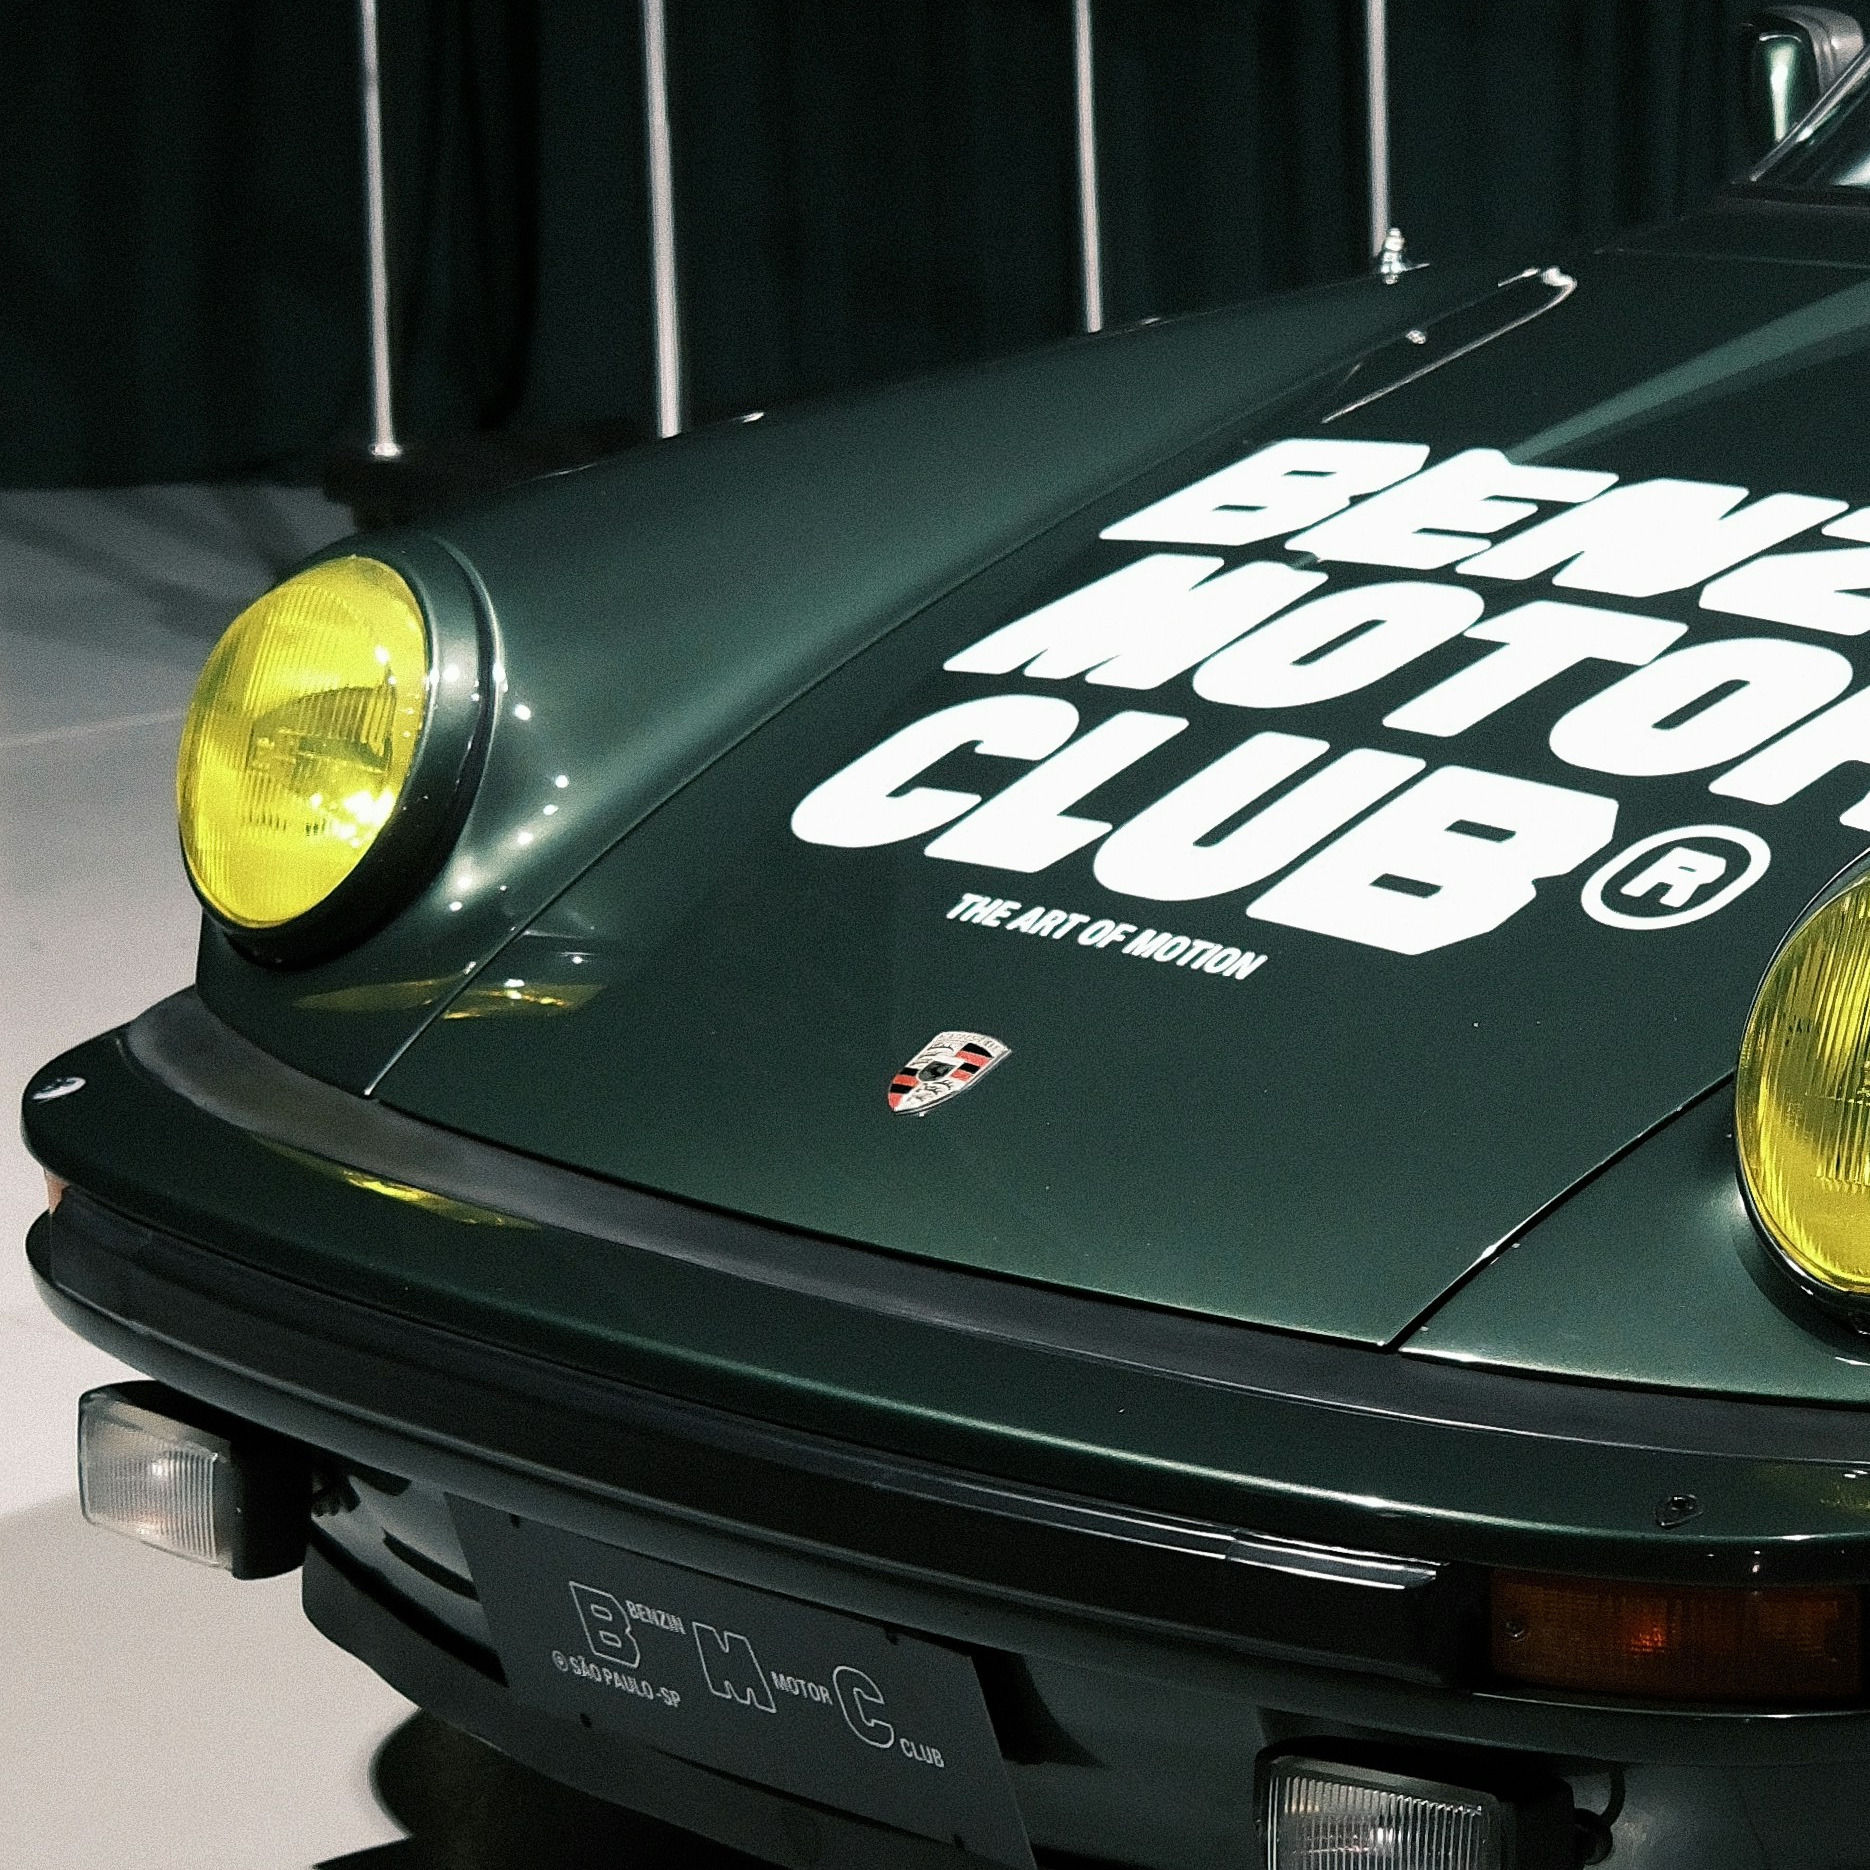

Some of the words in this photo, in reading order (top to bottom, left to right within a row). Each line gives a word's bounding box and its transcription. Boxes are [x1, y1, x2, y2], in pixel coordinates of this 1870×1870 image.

[946, 892, 1022, 928] THE
[1005, 905, 1091, 940] ART
[1077, 919, 1138, 948] OF
[1121, 928, 1268, 981] MOTION
[625, 1599, 687, 1635] BENZIN
[770, 1670, 834, 1706] MOTOR
[899, 1737, 945, 1769] CLUB
